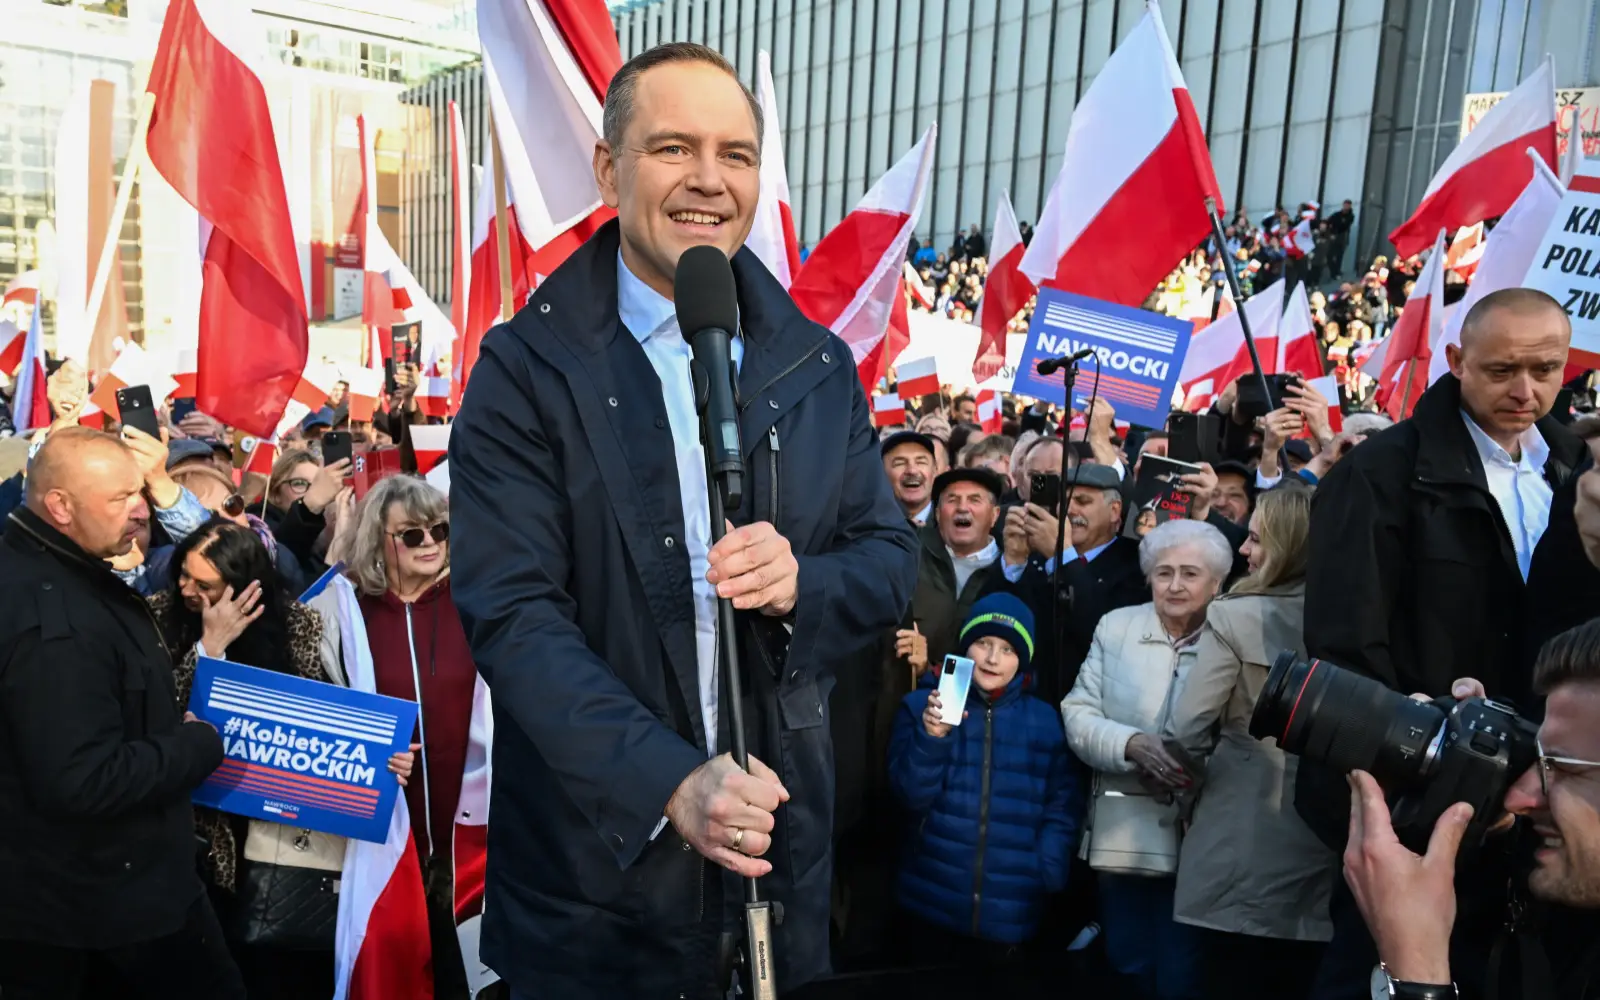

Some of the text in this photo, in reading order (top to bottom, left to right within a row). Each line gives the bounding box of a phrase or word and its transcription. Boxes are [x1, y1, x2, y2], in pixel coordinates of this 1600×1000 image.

[1563, 205, 1600, 237] KA
[1036, 332, 1170, 381] NAWROCKI
[223, 716, 368, 764] #KobietyZA
